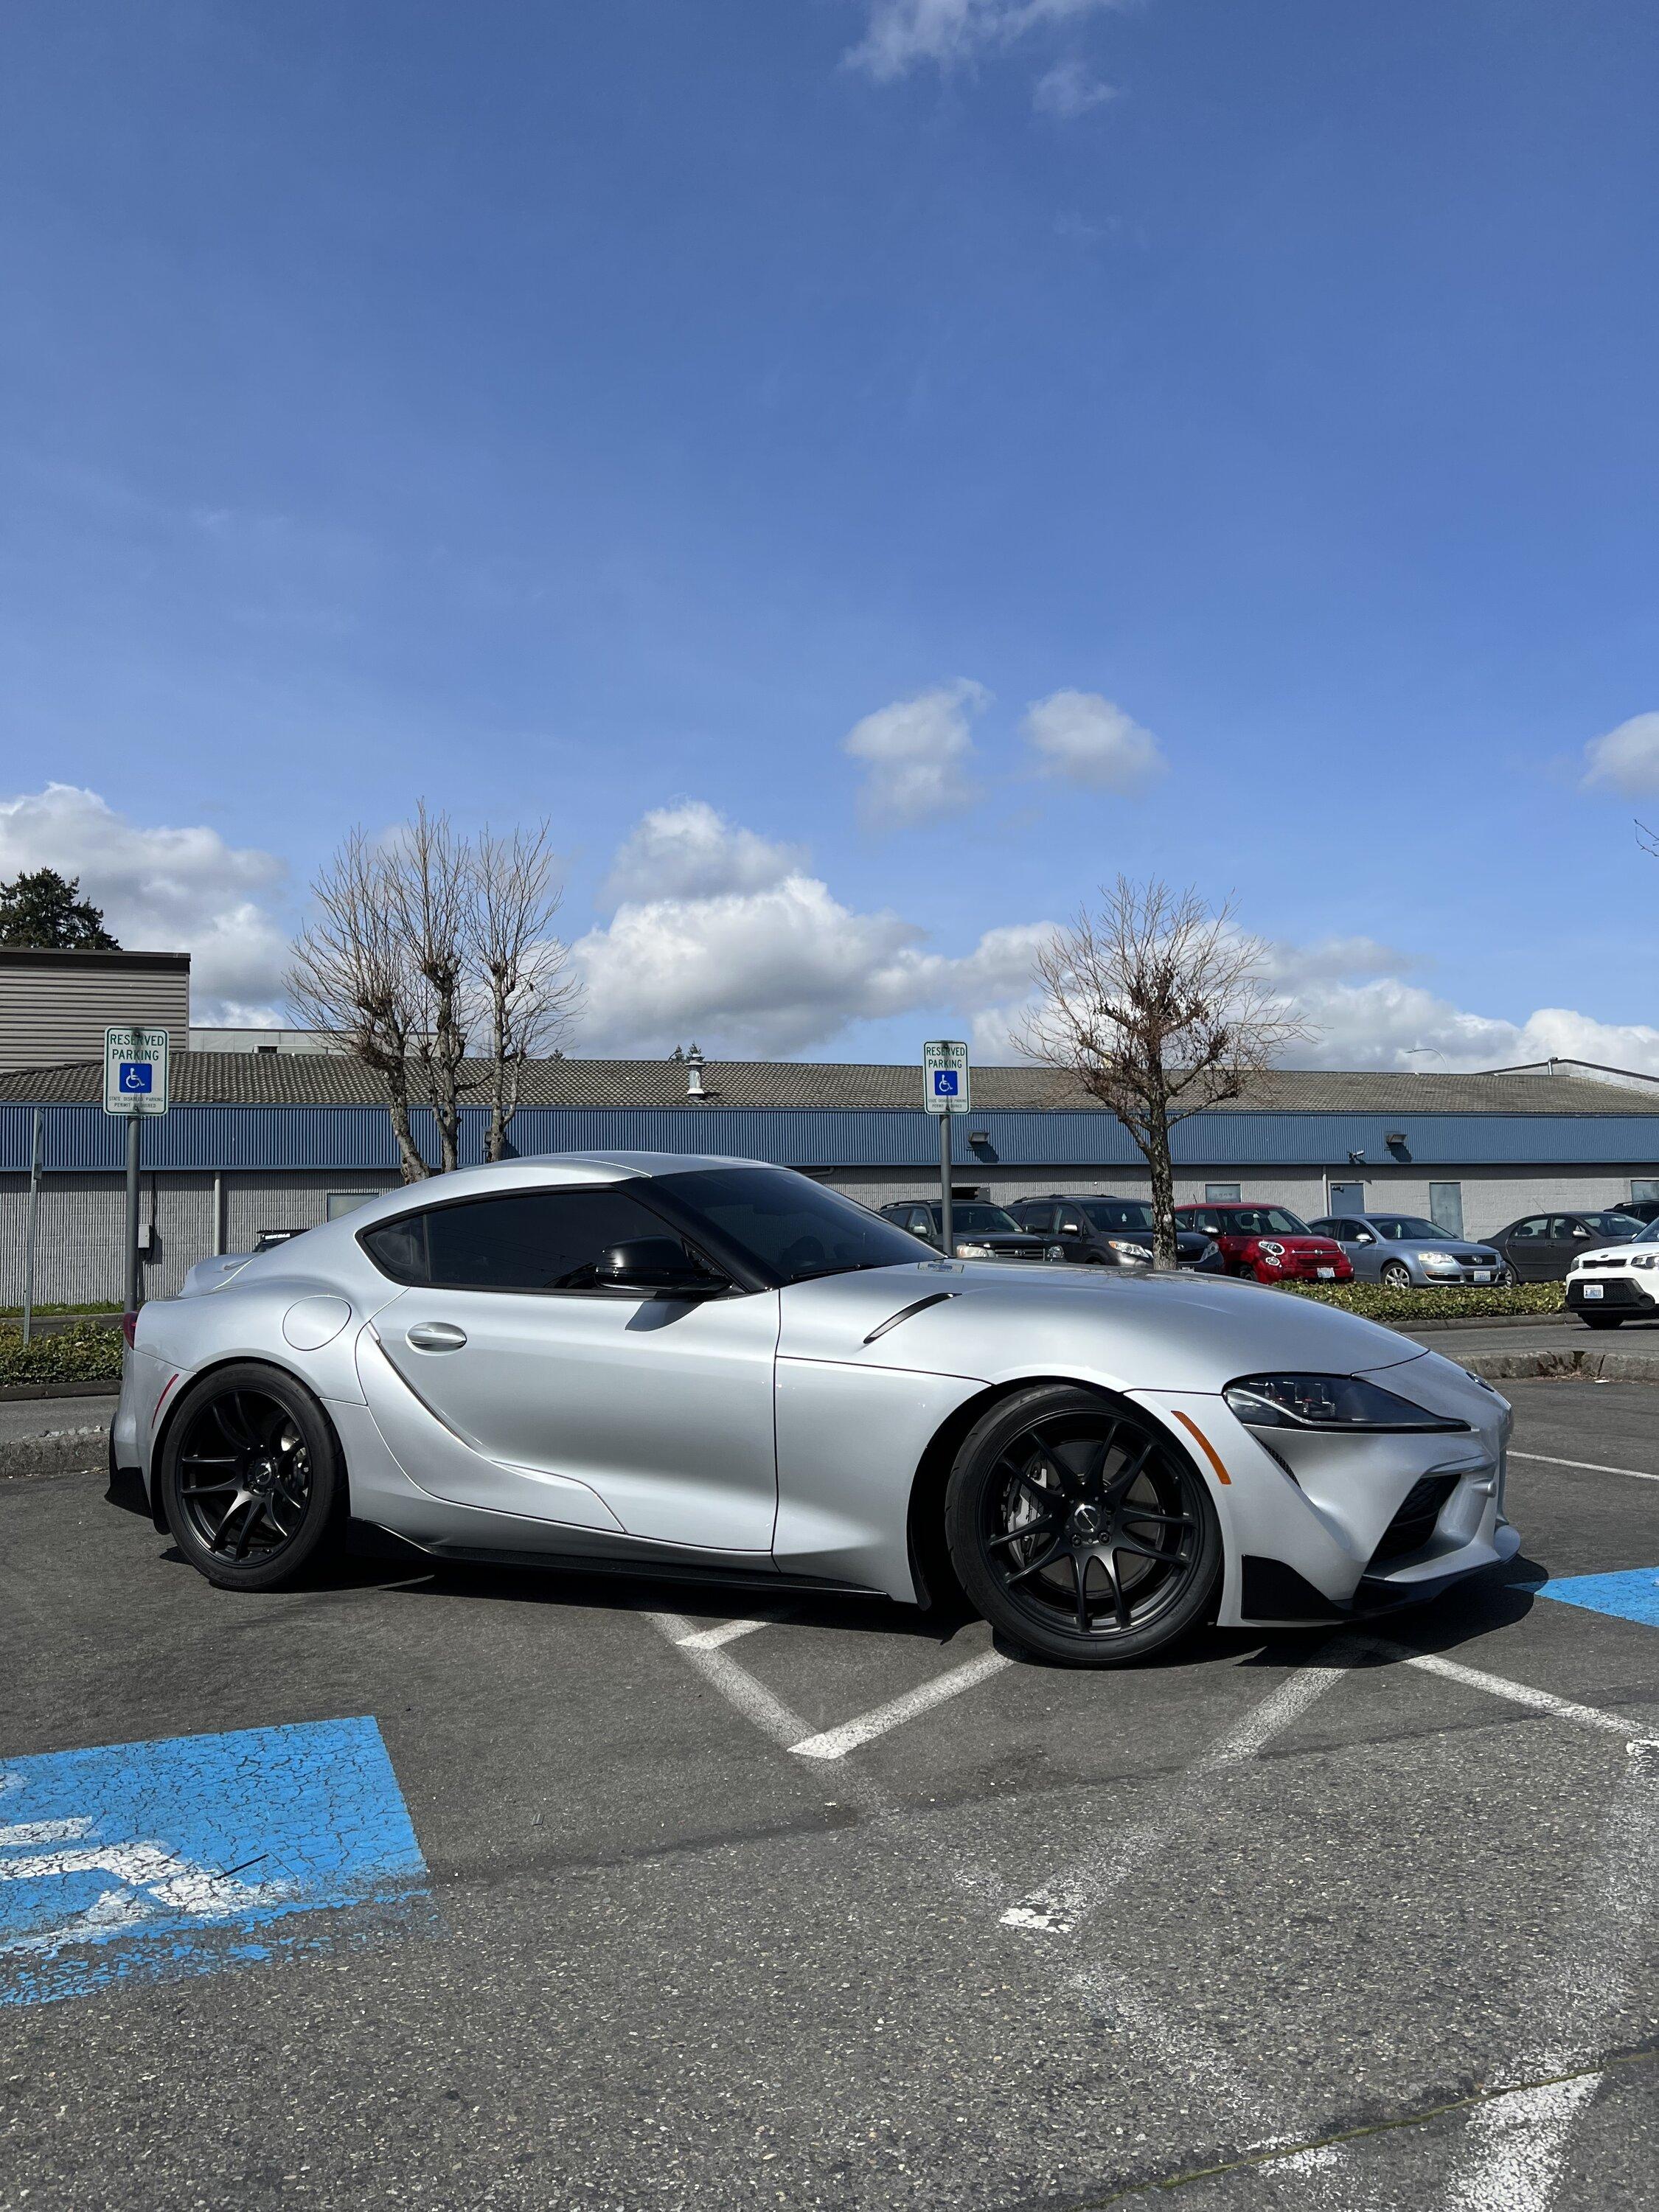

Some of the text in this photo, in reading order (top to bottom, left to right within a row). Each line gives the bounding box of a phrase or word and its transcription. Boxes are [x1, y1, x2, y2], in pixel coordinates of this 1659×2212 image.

[110, 1034, 164, 1046] RESERVED
[112, 1048, 159, 1060] PARKING
[926, 1046, 965, 1057] RESERVED
[928, 1059, 962, 1068] PARKING
